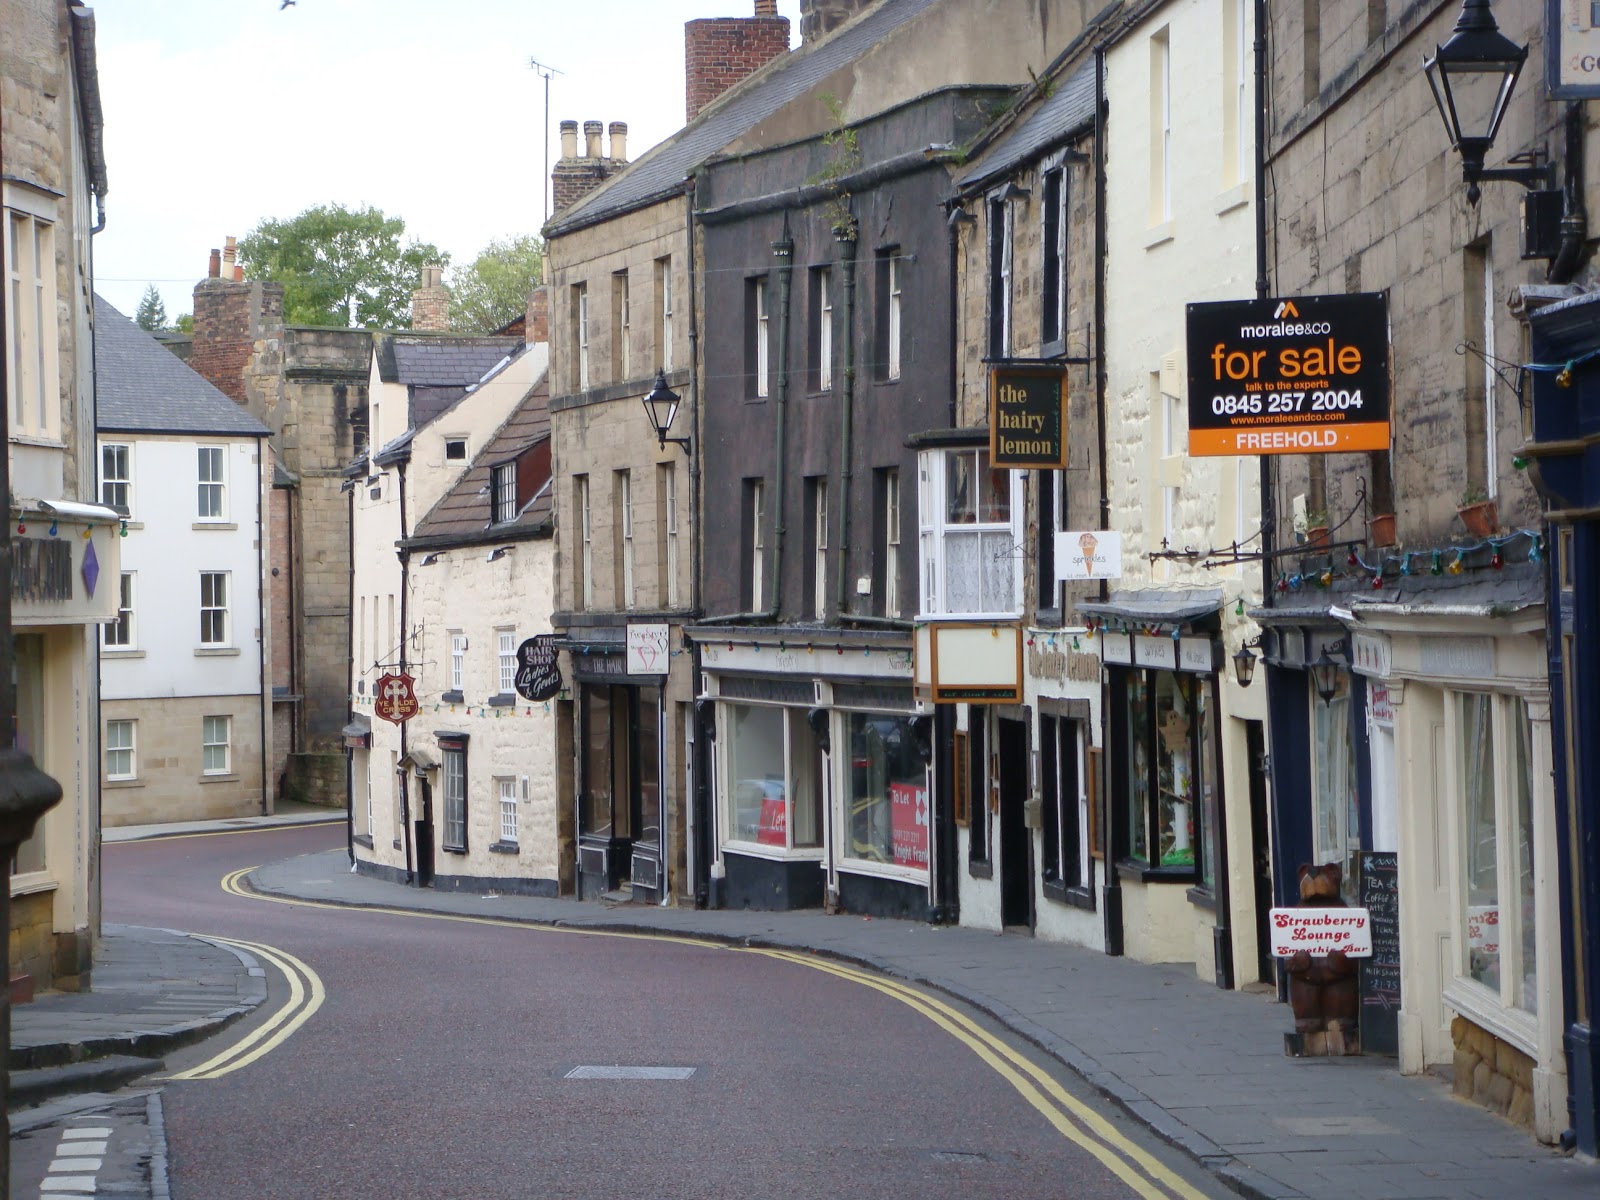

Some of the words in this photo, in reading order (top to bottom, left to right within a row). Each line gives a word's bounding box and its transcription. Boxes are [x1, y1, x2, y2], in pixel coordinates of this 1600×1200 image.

[1241, 321, 1331, 338] moralee&co
[1211, 343, 1266, 380] for
[1279, 338, 1361, 378] sale
[999, 384, 1027, 403] the
[1245, 382, 1262, 392] talk
[1265, 382, 1274, 391] to
[1277, 381, 1291, 390] the
[1294, 379, 1329, 391] experts
[1212, 395, 1262, 415] 0845
[1268, 392, 1305, 412] 257
[1312, 389, 1363, 411] 2004
[999, 410, 1045, 434] hairy
[1231, 412, 1345, 425] www.moraleeandco.com
[999, 436, 1052, 455] lemon
[1236, 430, 1338, 449] FREEHOLD
[1072, 554, 1106, 566] sprinkles
[537, 638, 556, 646] THE
[526, 655, 555, 665] SHOP
[593, 658, 604, 673] THE
[606, 658, 623, 673] HAIR
[1066, 642, 1100, 682] lemon
[518, 665, 549, 687] Ladies
[526, 687, 533, 698] &
[533, 671, 559, 697] Gents
[892, 790, 899, 803] To
[900, 791, 909, 805] Let
[894, 843, 911, 863] Knight
[1365, 876, 1384, 889] TEA
[1274, 914, 1365, 928] Strawberry
[1291, 927, 1350, 943] Lounge
[1340, 943, 1368, 954] Bar
